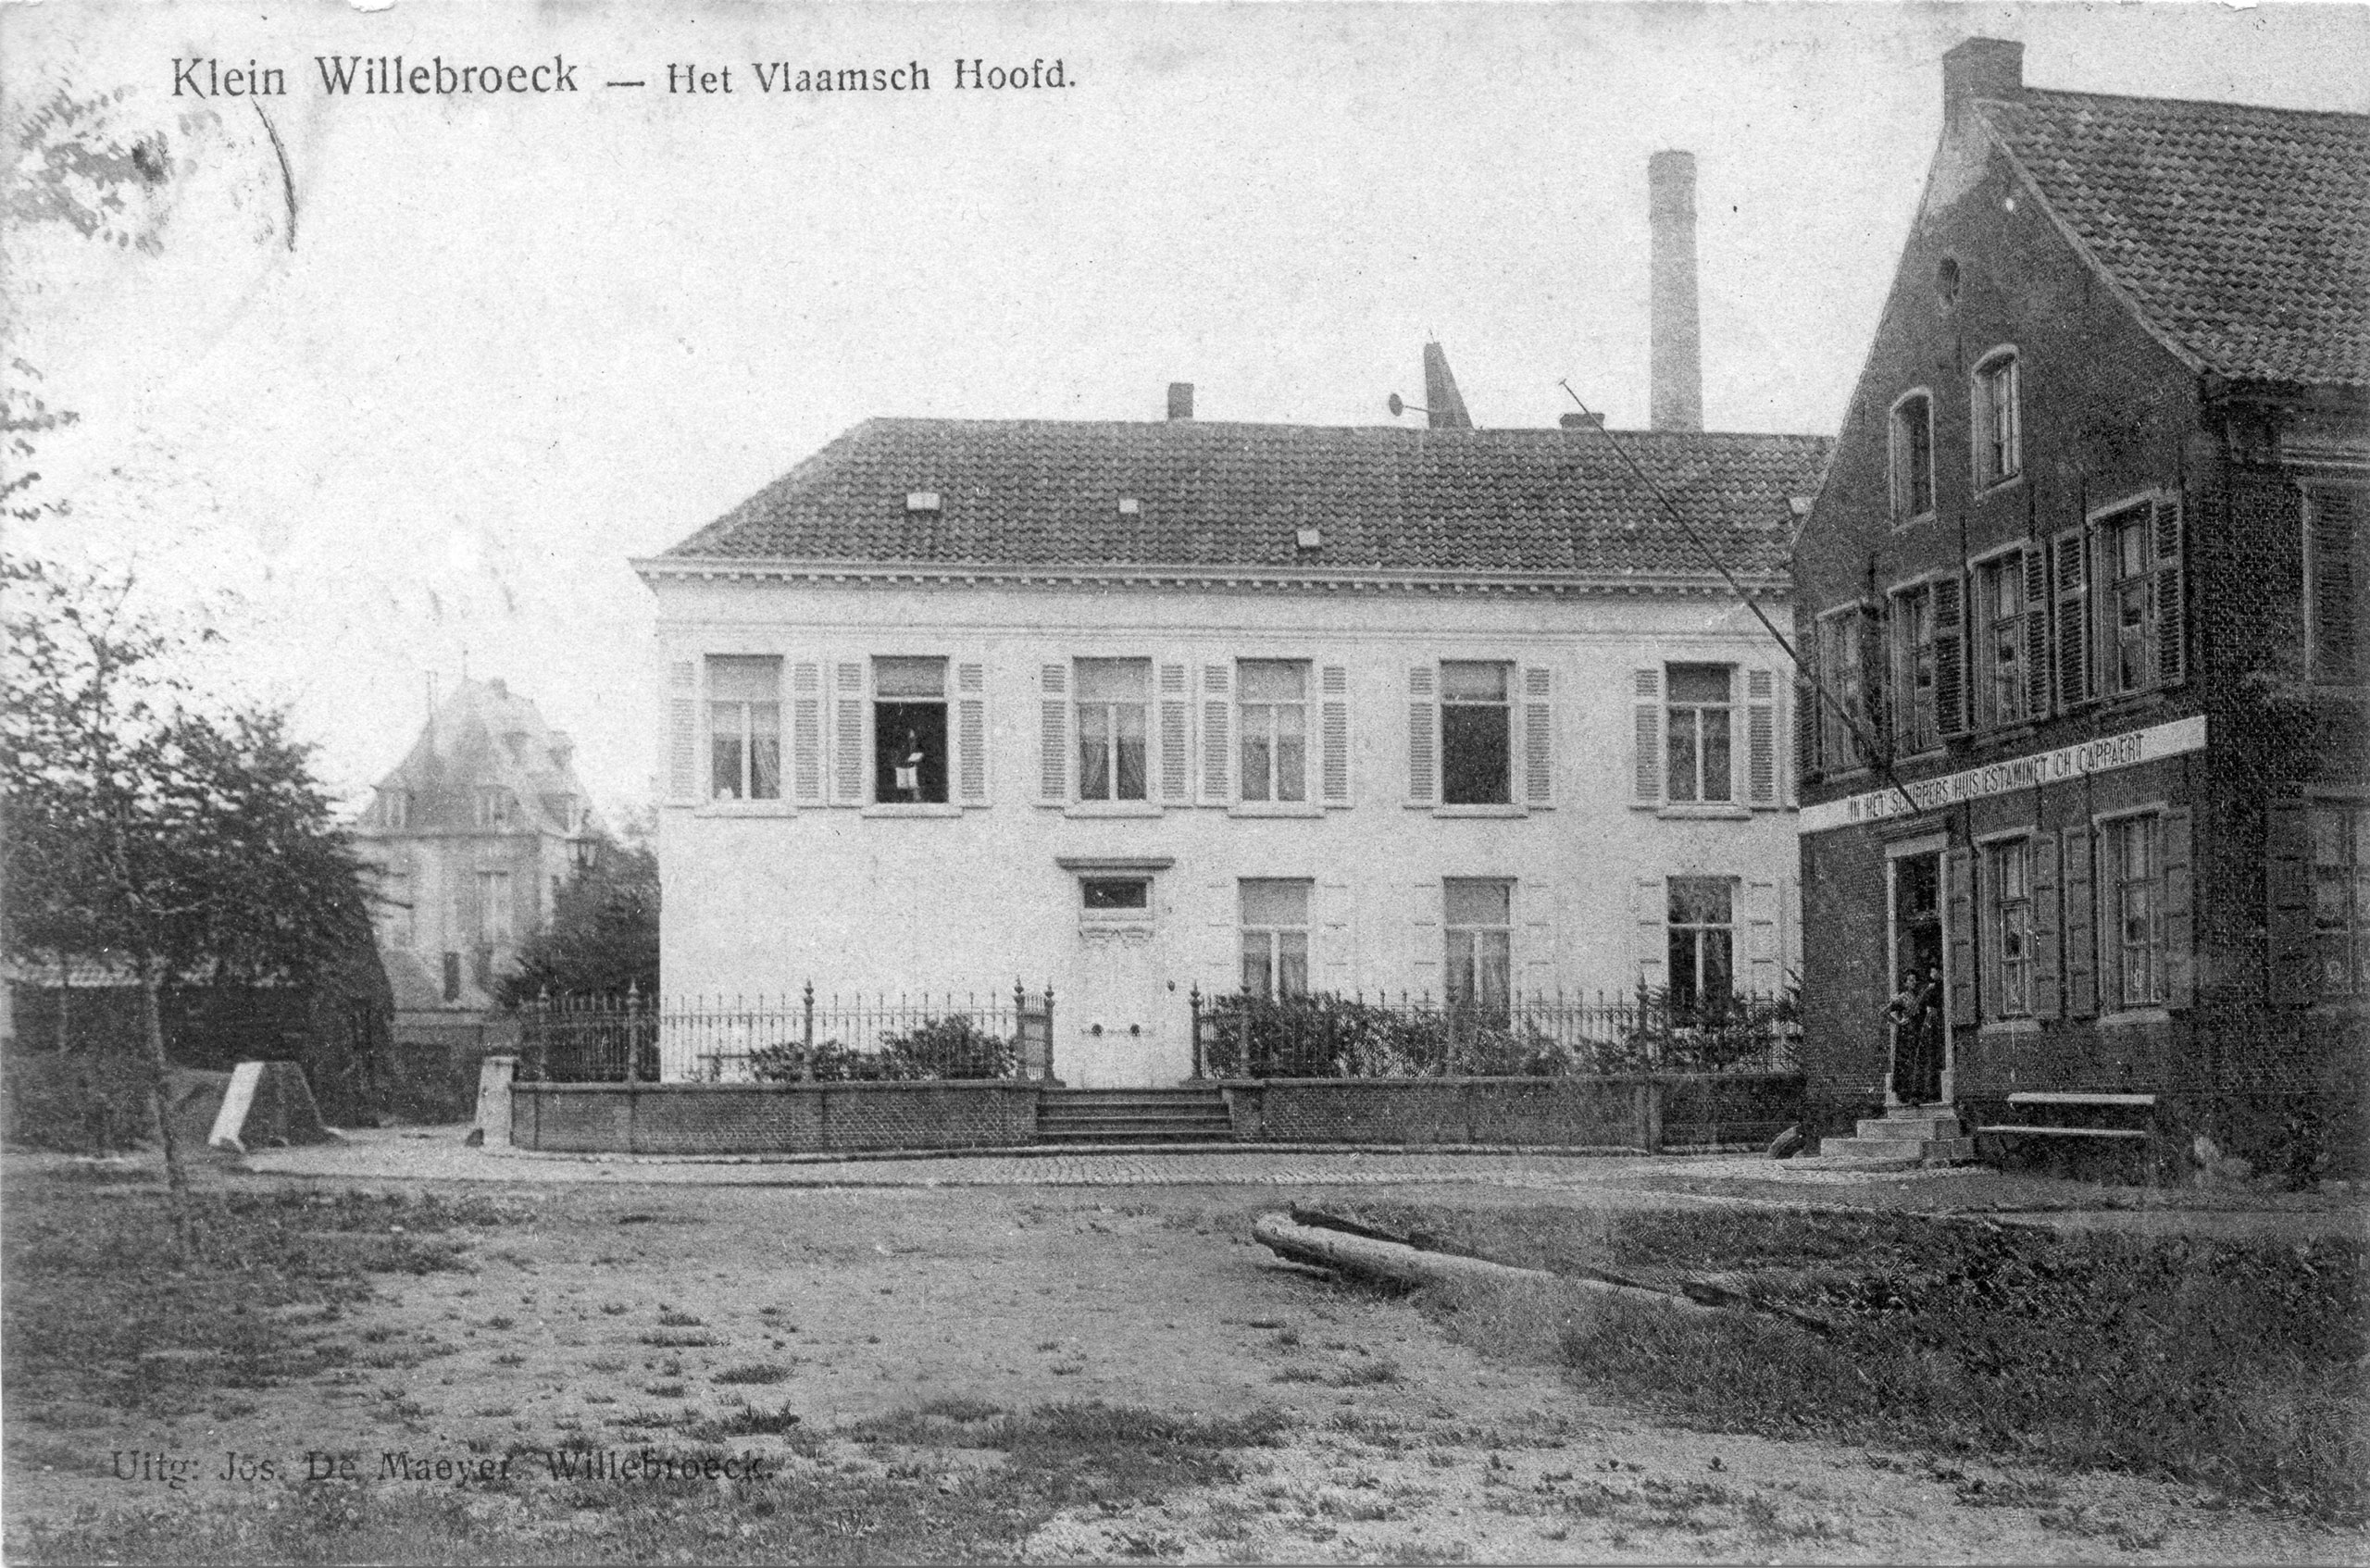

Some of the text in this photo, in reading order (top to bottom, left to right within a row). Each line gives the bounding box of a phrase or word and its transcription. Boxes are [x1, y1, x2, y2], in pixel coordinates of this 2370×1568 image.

[1848, 800, 1861, 822] IN
[1865, 793, 1885, 817] HET
[1953, 771, 1979, 797] HUIS
[1984, 757, 2048, 793] ESTAMINET
[2077, 733, 2144, 772] CAPPAERT
